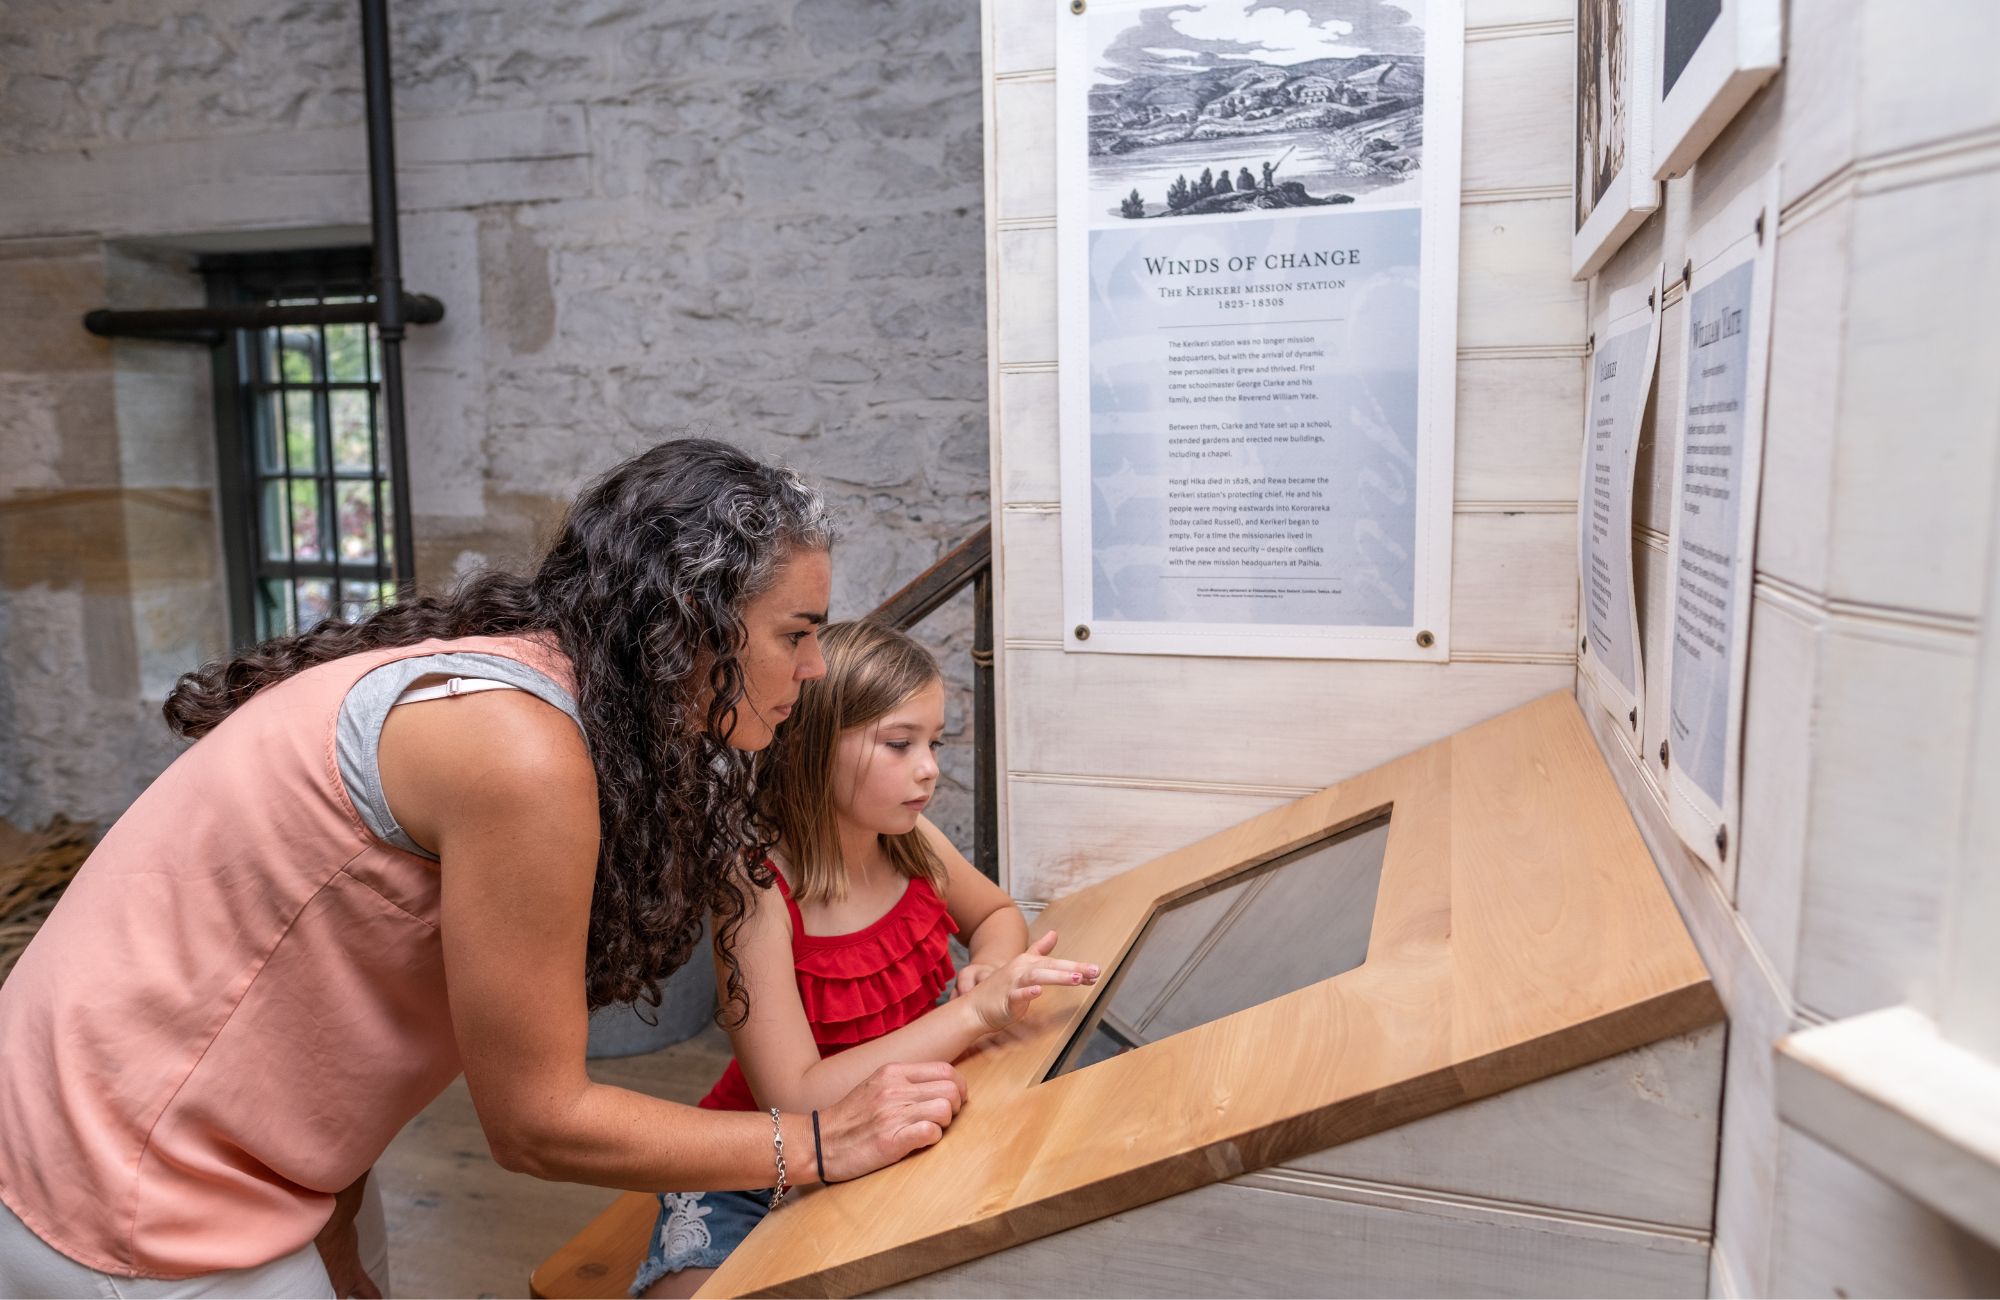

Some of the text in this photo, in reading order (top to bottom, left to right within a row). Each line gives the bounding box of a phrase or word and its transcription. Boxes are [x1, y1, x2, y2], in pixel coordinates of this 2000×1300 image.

[1144, 249, 1361, 276] WINDS OF CHANGE
[1159, 280, 1346, 298] THE KERIKERI MISSION STATION
[1168, 340, 1182, 349] The
[1182, 340, 1210, 349] Kerikeri
[1210, 339, 1236, 348] station
[1263, 337, 1286, 347] longer
[1286, 335, 1315, 344] mission
[1168, 349, 1325, 363] headquarters, but with the arrival of dynamic
[1184, 367, 1230, 377] personalities
[1230, 367, 1236, 375] it
[1237, 367, 1255, 376] grew
[1256, 366, 1270, 374] and
[1299, 364, 1315, 372] First
[1168, 378, 1313, 391] came schoolmaster George Clarke and his
[1168, 396, 1192, 405] family,
[1193, 395, 1207, 404] and
[1207, 395, 1224, 403] then
[1238, 394, 1272, 402] Reverend
[1272, 393, 1299, 401] William
[1300, 393, 1319, 401] Yate.
[1168, 423, 1199, 431] Between
[1200, 423, 1220, 431] them,
[1221, 422, 1244, 431] Clarke
[1244, 422, 1259, 430] and
[1259, 422, 1276, 430] Yate
[1289, 422, 1299, 430] up
[1306, 420, 1333, 429] school,
[1168, 437, 1201, 445] extended
[1202, 436, 1230, 446] gardens
[1231, 436, 1245, 444] and
[1246, 436, 1273, 444] erected
[1290, 434, 1326, 444] buildings,
[1168, 450, 1201, 460] including
[1207, 450, 1233, 459] chapel.
[1169, 478, 1189, 487] Hongi
[1190, 478, 1206, 486] Hika
[1207, 478, 1223, 486] died
[1252, 477, 1266, 485] and
[1267, 476, 1287, 485] Rewa
[1288, 476, 1316, 485] became
[1227, 491, 1264, 500] protecting
[1285, 490, 1296, 499] He
[1311, 490, 1323, 498] his
[1169, 505, 1193, 513] people
[1212, 506, 1238, 514] moving
[1238, 504, 1275, 512] eastwards
[1169, 518, 1191, 527] (today
[1192, 518, 1213, 526] called
[1245, 518, 1259, 526] and
[1260, 518, 1288, 526] Kerikeri
[1288, 518, 1311, 528] began
[1168, 532, 1192, 541] empty.
[1193, 532, 1205, 540] For
[1211, 532, 1228, 540] time
[1228, 532, 1241, 540] the
[1241, 532, 1286, 540] missionaries
[1287, 532, 1305, 540] lived
[1305, 532, 1313, 540] in
[1169, 545, 1195, 553] relative
[1195, 546, 1217, 554] peace
[1217, 545, 1231, 553] and
[1232, 545, 1260, 554] security
[1266, 546, 1293, 554] despite
[1294, 545, 1324, 554] conflicts
[1213, 559, 1240, 567] mission
[1241, 559, 1288, 569] headquarters
